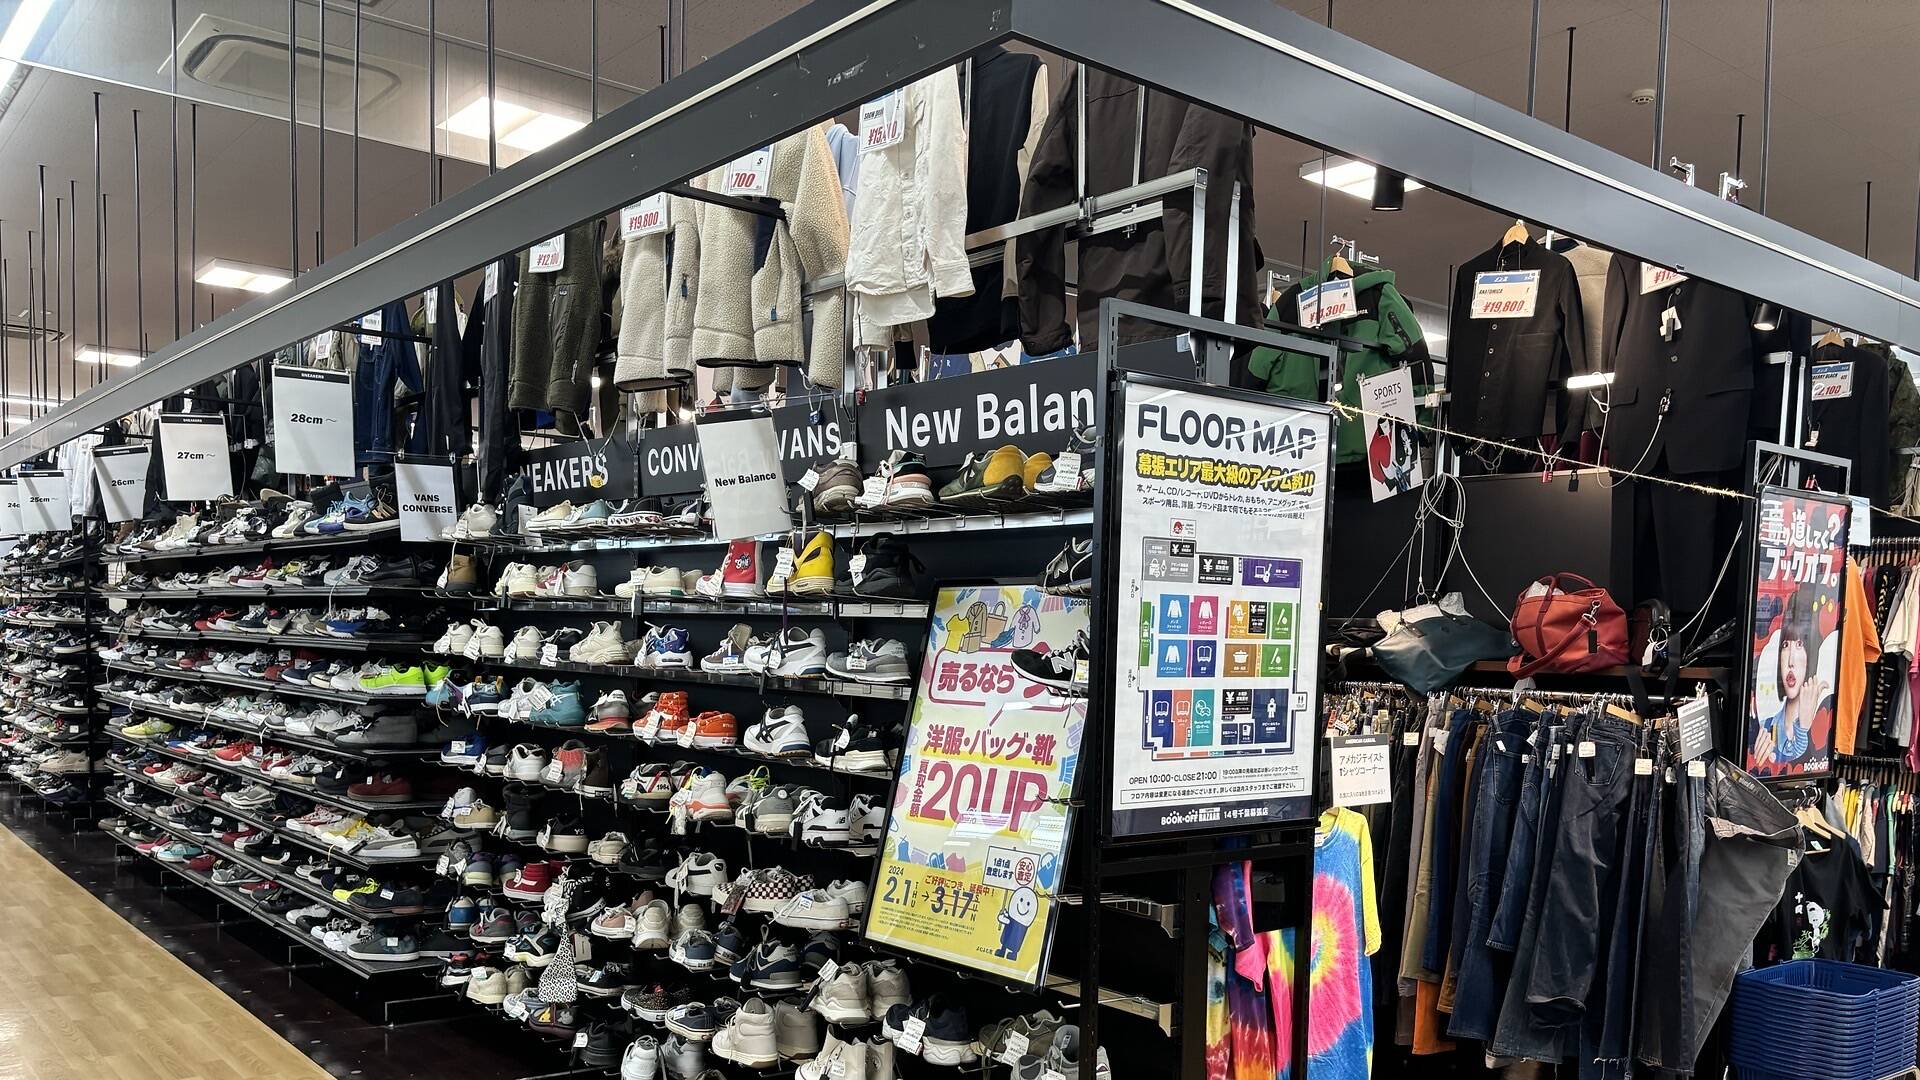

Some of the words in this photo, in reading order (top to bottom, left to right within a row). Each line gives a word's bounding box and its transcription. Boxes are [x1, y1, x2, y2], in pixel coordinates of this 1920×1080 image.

[628, 211, 659, 230] ¥19,800
[1482, 300, 1525, 313] ¥19,800
[301, 372, 325, 380] SNEAKERS
[1373, 381, 1402, 401] SPORTS
[885, 406, 963, 451] New
[975, 382, 1095, 441] Balan
[776, 420, 840, 462] VANS
[1137, 403, 1246, 452] FLOOR
[1252, 419, 1317, 460] MAP
[715, 477, 736, 488] New
[738, 471, 777, 485] Balance
[414, 493, 440, 502] VANS
[402, 504, 454, 514] CONVERSE
[1765, 547, 1838, 587] ブックオフ。
[937, 660, 1015, 695] 売るなら
[923, 723, 1057, 766] 洋服・バッグ・靴
[1129, 776, 1148, 785] OPEN
[1196, 771, 1218, 780] 21:00
[888, 865, 905, 876] 2024
[883, 876, 912, 906] 2.1
[931, 885, 974, 919] 3.17
